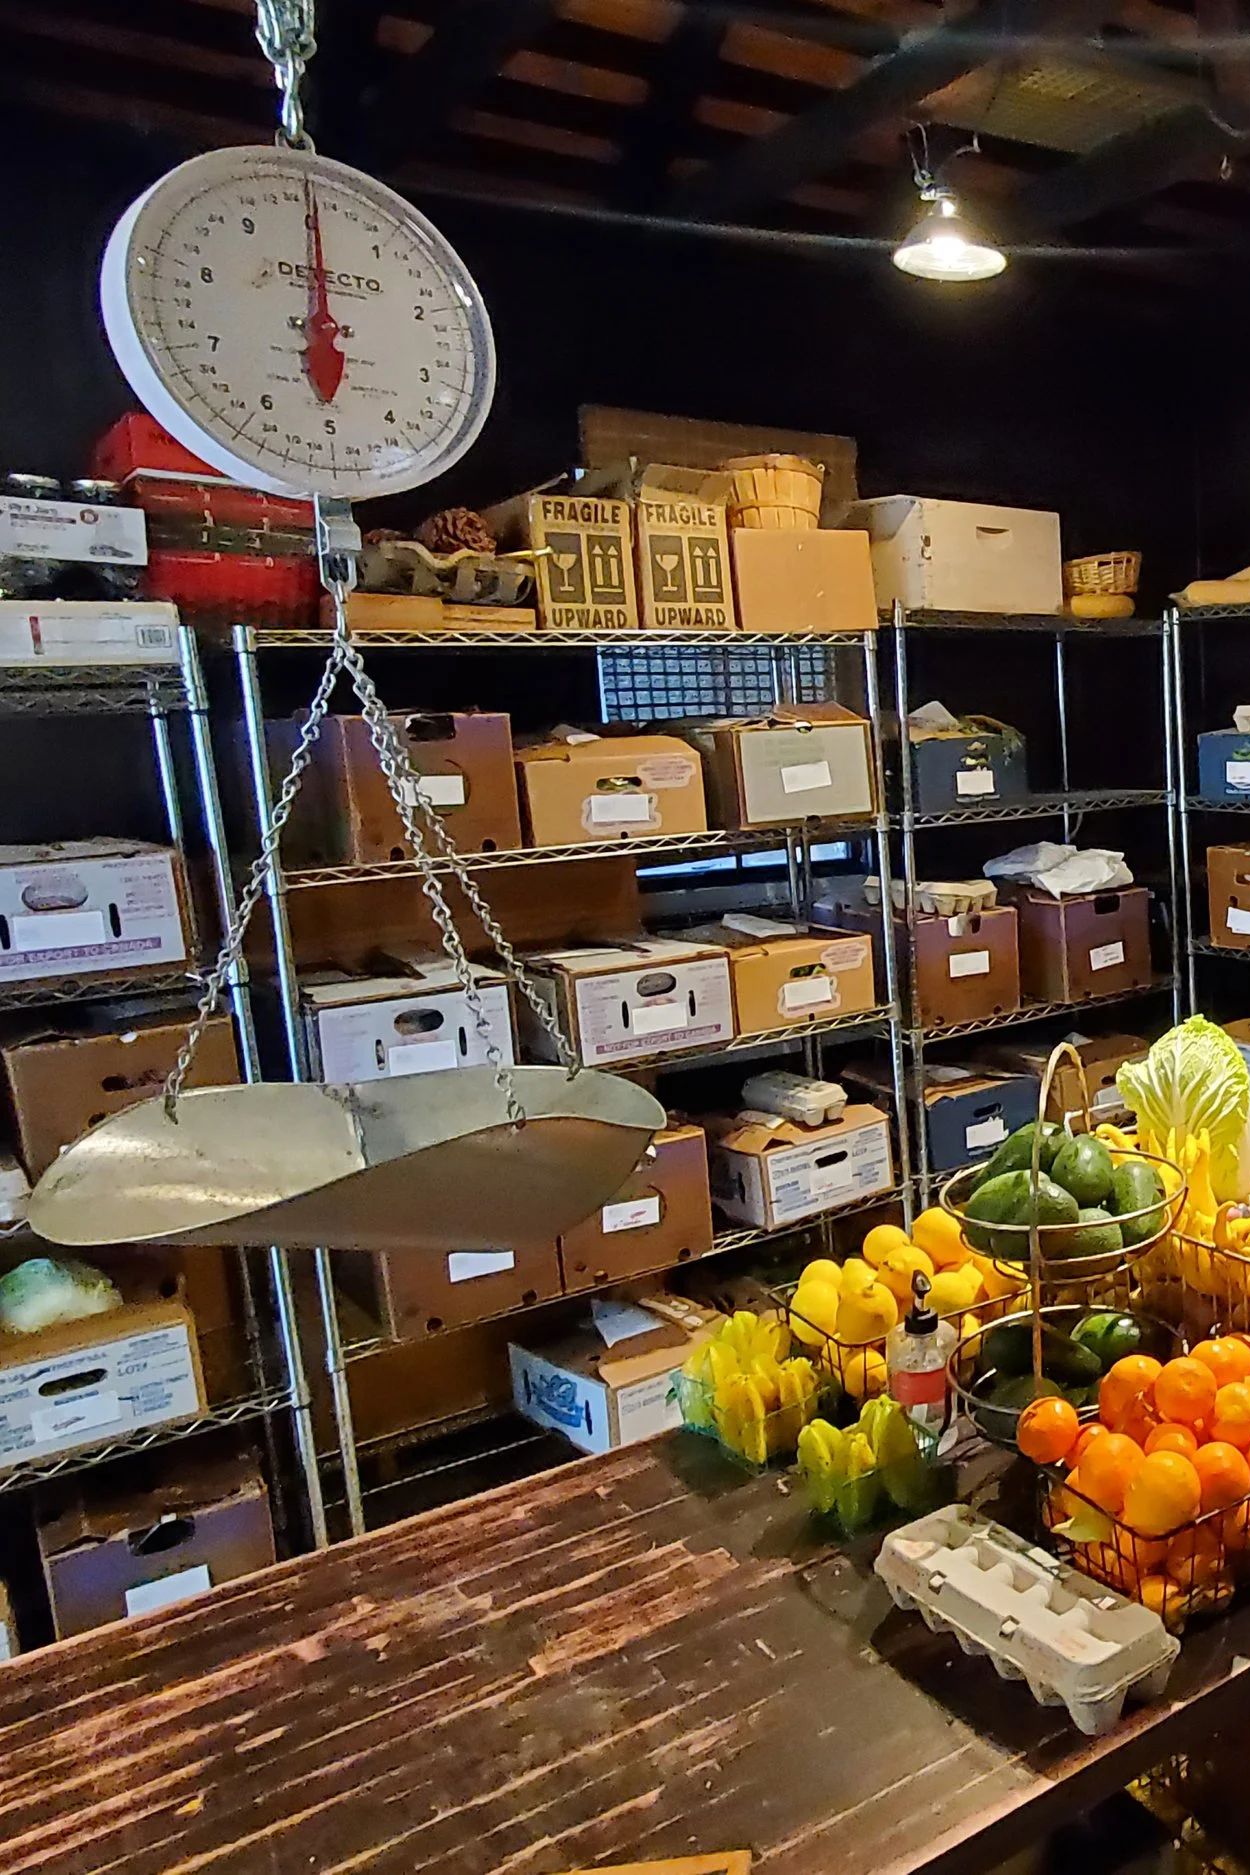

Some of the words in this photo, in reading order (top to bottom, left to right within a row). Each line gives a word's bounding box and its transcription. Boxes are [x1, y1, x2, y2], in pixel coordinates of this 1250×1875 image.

[241, 217, 255, 234] 9
[372, 244, 380, 259] 1
[201, 267, 214, 283] 8
[413, 305, 425, 321] 2
[207, 335, 220, 352] 7
[419, 367, 430, 383] 3
[260, 394, 273, 411] 6
[384, 410, 396, 424] 4
[324, 419, 336, 435] 5
[541, 500, 621, 524] FRAGILE
[645, 503, 717, 527] FRAGILE
[551, 607, 628, 629] UPWARD
[654, 606, 726, 627] UPWARD
